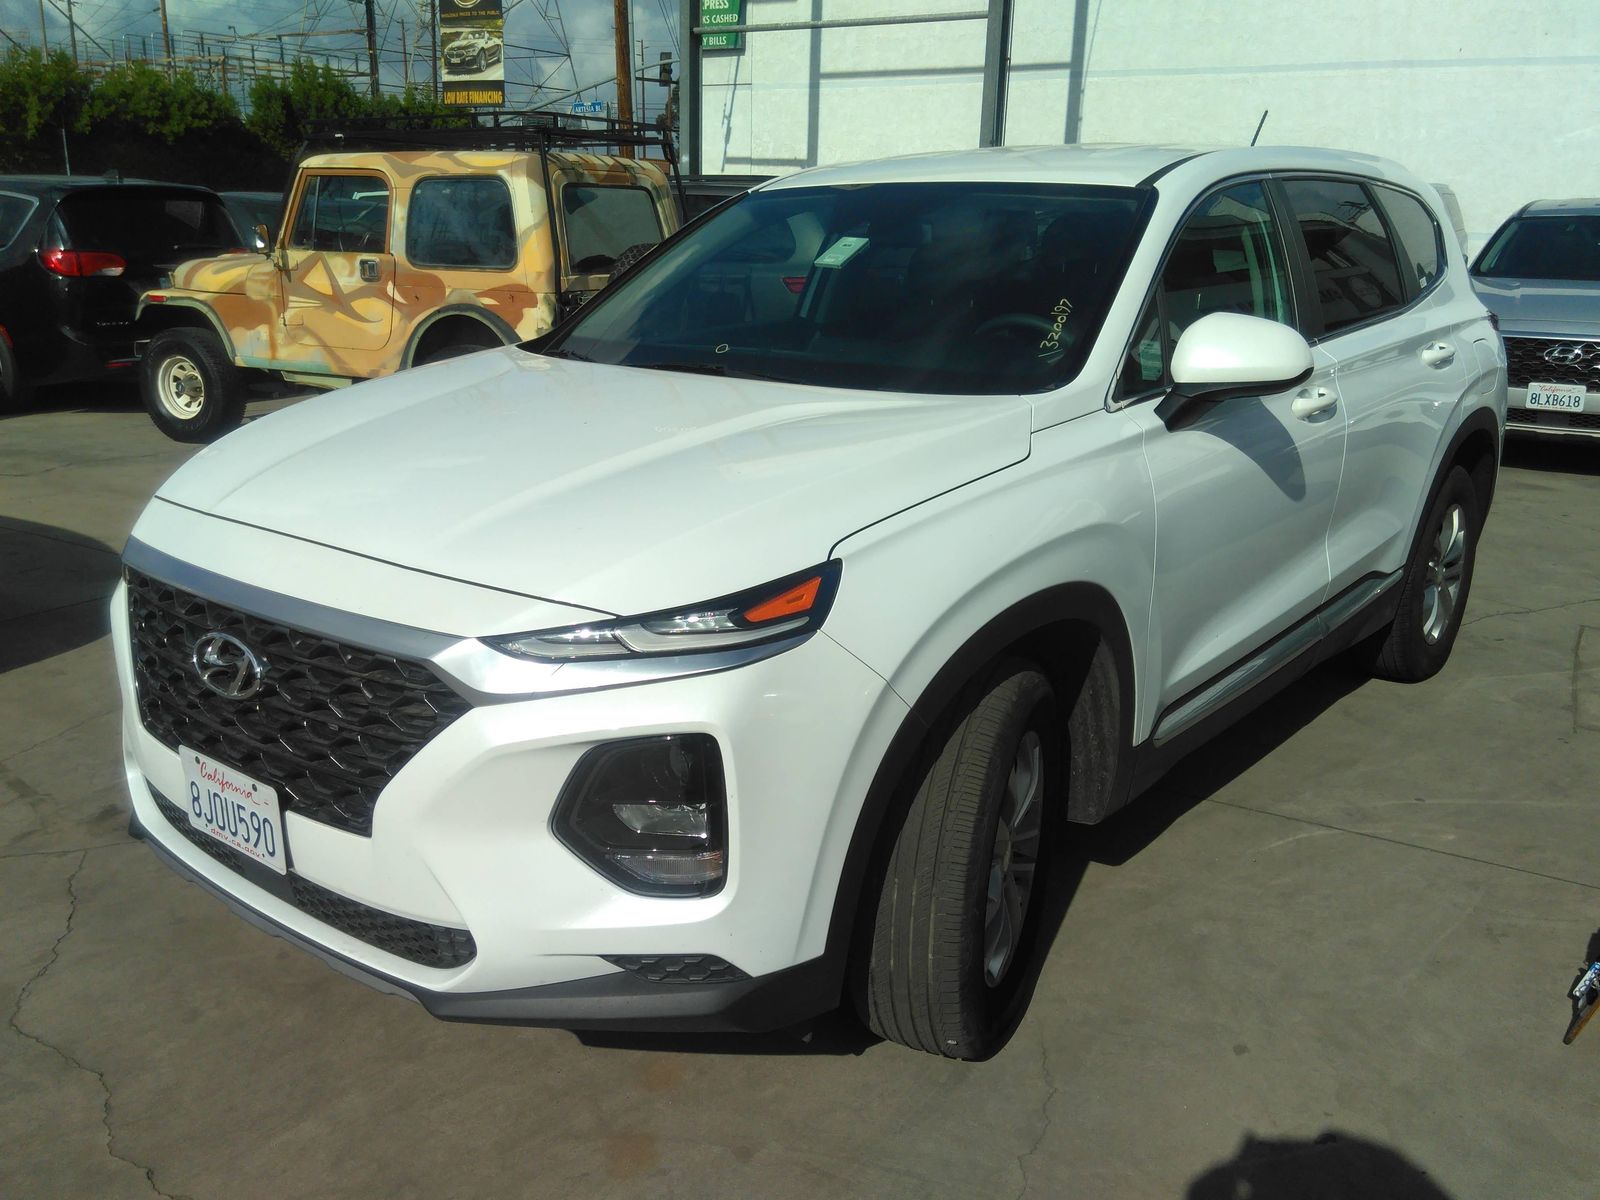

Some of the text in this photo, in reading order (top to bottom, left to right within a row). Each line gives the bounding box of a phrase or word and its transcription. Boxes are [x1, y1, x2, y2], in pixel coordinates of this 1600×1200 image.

[702, 0, 729, 9] PRESS
[711, 13, 739, 24] CASHED
[709, 36, 727, 46] BILLS
[444, 90, 503, 105] LOW RATE FINANCING
[575, 105, 595, 113] ARTESIA
[1529, 392, 1581, 408] 8LXB618
[200, 761, 260, 805] California
[190, 780, 276, 858] 8JOU590
